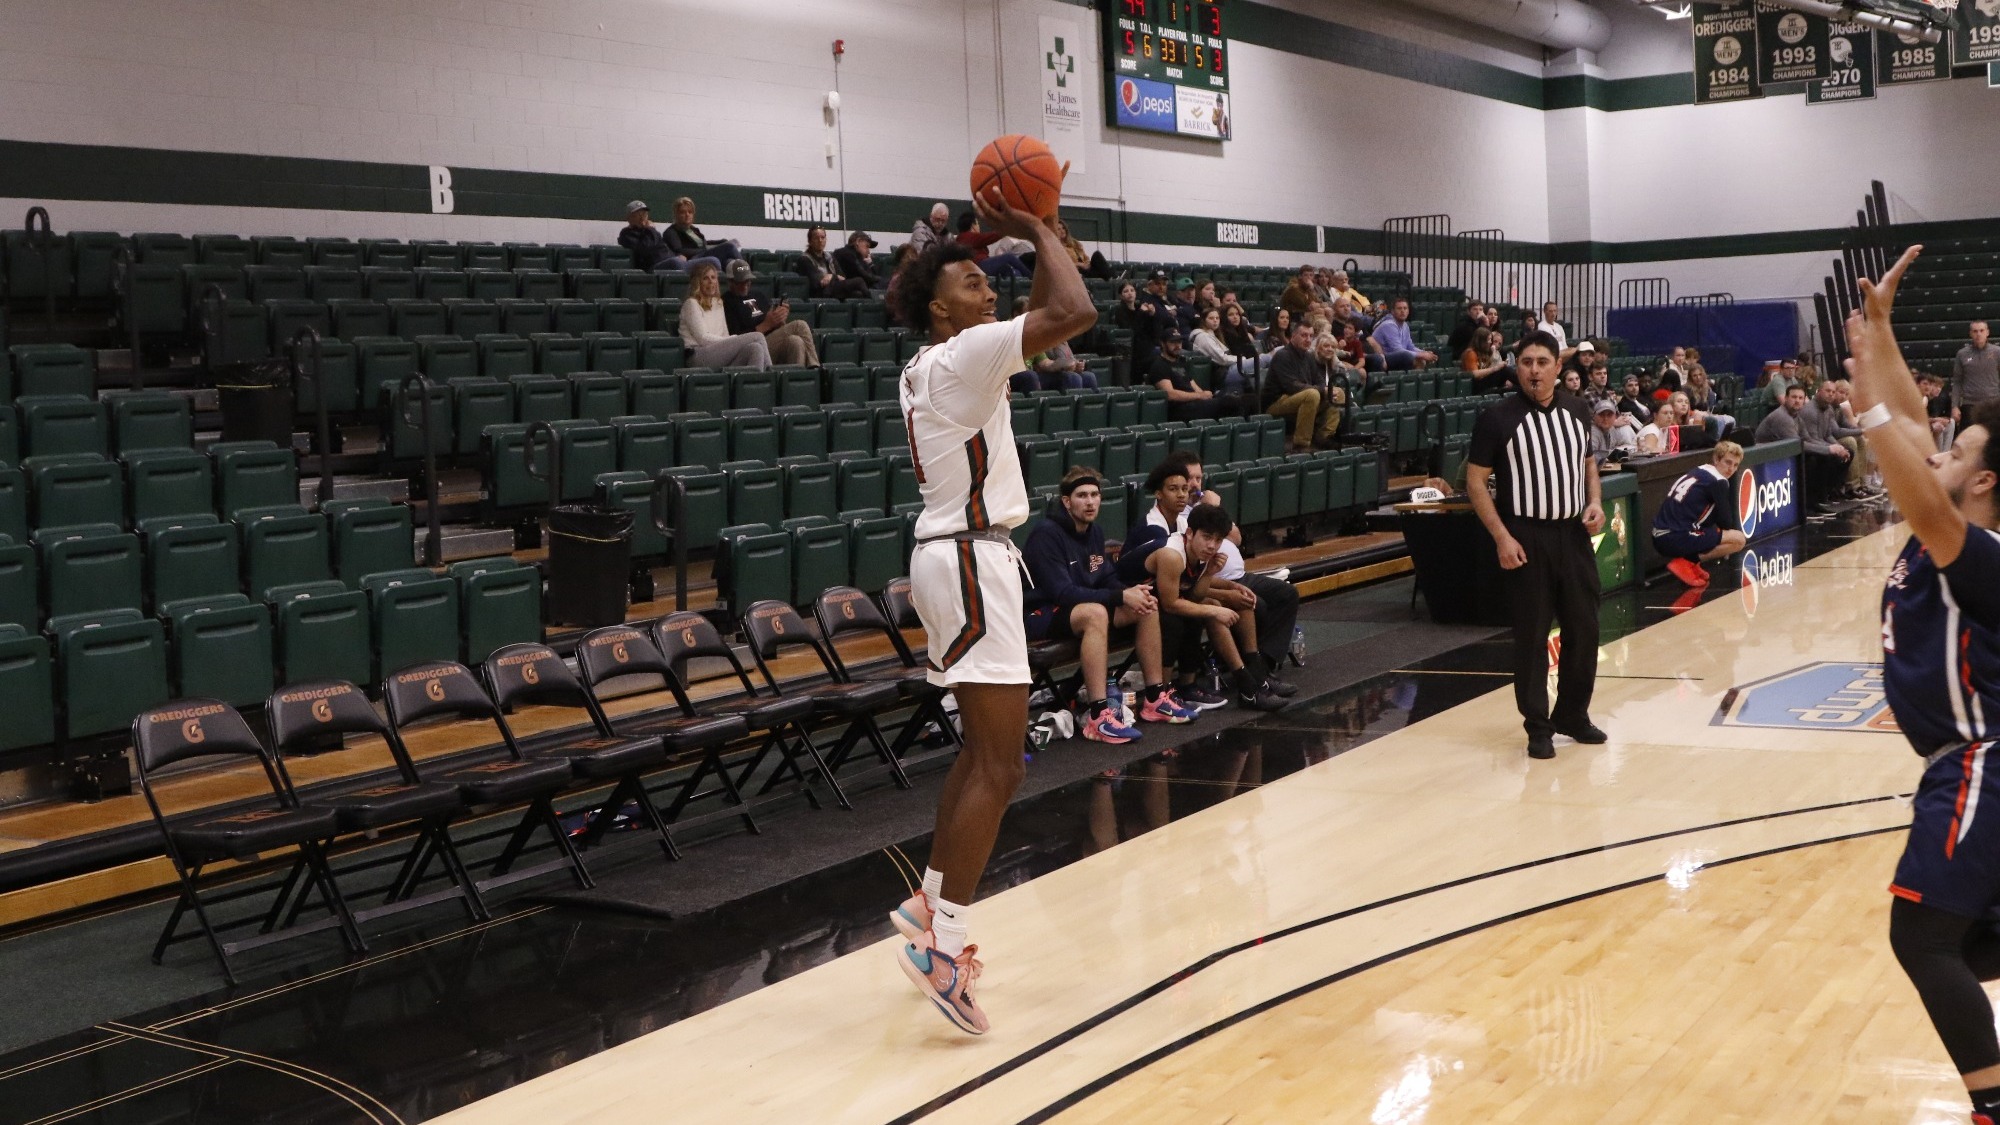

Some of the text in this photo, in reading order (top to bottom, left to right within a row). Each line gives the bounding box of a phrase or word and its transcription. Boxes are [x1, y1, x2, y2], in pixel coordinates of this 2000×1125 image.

[1119, 18, 1136, 31] FOULS
[1211, 7, 1220, 36] 3
[1703, 10, 1749, 21] MONTANA TECH
[1125, 31, 1135, 55] 5
[1158, 27, 1188, 42] PLAYER FOUL
[1208, 37, 1222, 49] FOULS
[1143, 34, 1152, 58] 6
[1160, 38, 1176, 62] 33
[1121, 58, 1137, 71] SCORE
[1195, 45, 1204, 68] 5
[1214, 49, 1222, 72] 3
[1772, 45, 1816, 66] 1993
[1892, 47, 1936, 67] 1985
[1166, 66, 1183, 79] MATCH
[1209, 75, 1224, 87] SCORE
[1709, 66, 1750, 86] 1984
[1772, 68, 1817, 80] CHAMPIONS
[1892, 69, 1936, 81] CHAMPIONS
[1047, 90, 1077, 104] St. James
[1709, 88, 1750, 100] CHAMPIONS
[1821, 88, 1862, 100] CHAMPIONS
[1045, 103, 1081, 118] Healthcare
[1143, 96, 1173, 116] pepsi
[1184, 119, 1212, 131] BARRICK
[429, 165, 454, 213] B
[763, 192, 840, 223] RESERVED
[1217, 222, 1259, 245] RESERVED
[1416, 490, 1438, 499] DIGGERS
[1667, 474, 1698, 503] 14
[1758, 469, 1791, 523] pepsi
[588, 631, 641, 647] OREDIGGERS
[497, 650, 552, 667] OREDIGGERS
[397, 665, 461, 684] OREDIGGERS
[281, 685, 352, 703] OREDIGGERS
[150, 704, 225, 723] OREDIGGERS
